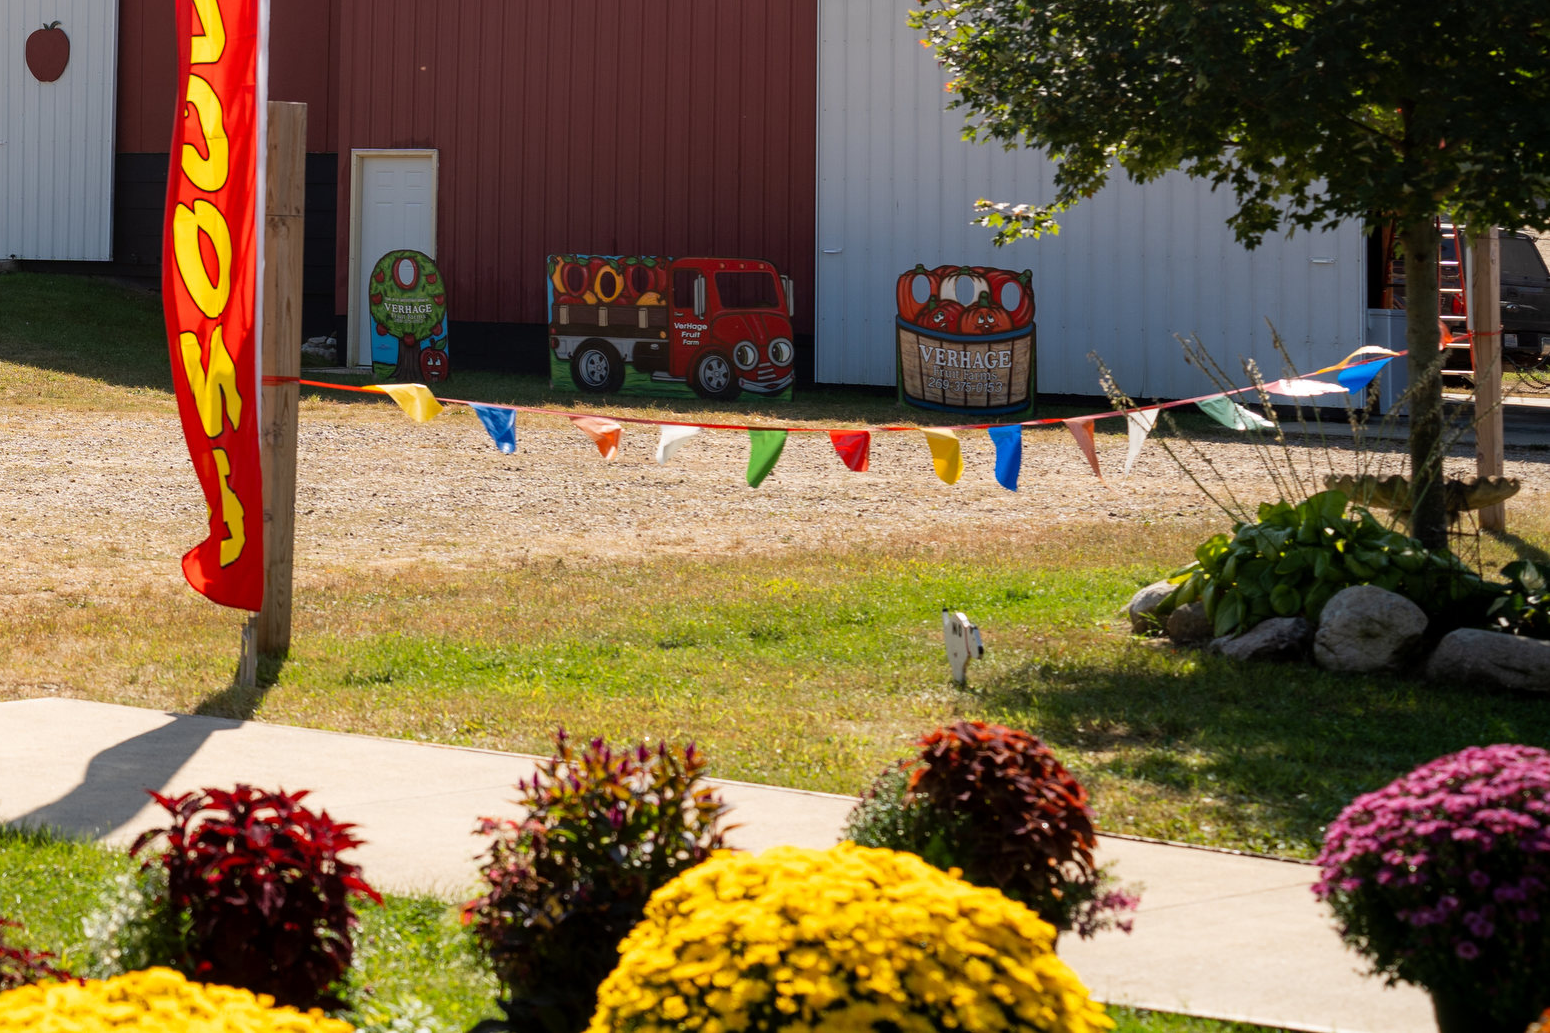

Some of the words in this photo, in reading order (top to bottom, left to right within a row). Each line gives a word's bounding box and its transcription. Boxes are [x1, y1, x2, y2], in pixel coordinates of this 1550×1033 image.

[384, 303, 433, 314] VERHAGE
[674, 322, 708, 331] VerHage
[919, 344, 1012, 369] VERHAGE
[933, 365, 959, 379] Fruit
[963, 369, 997, 381] Farms
